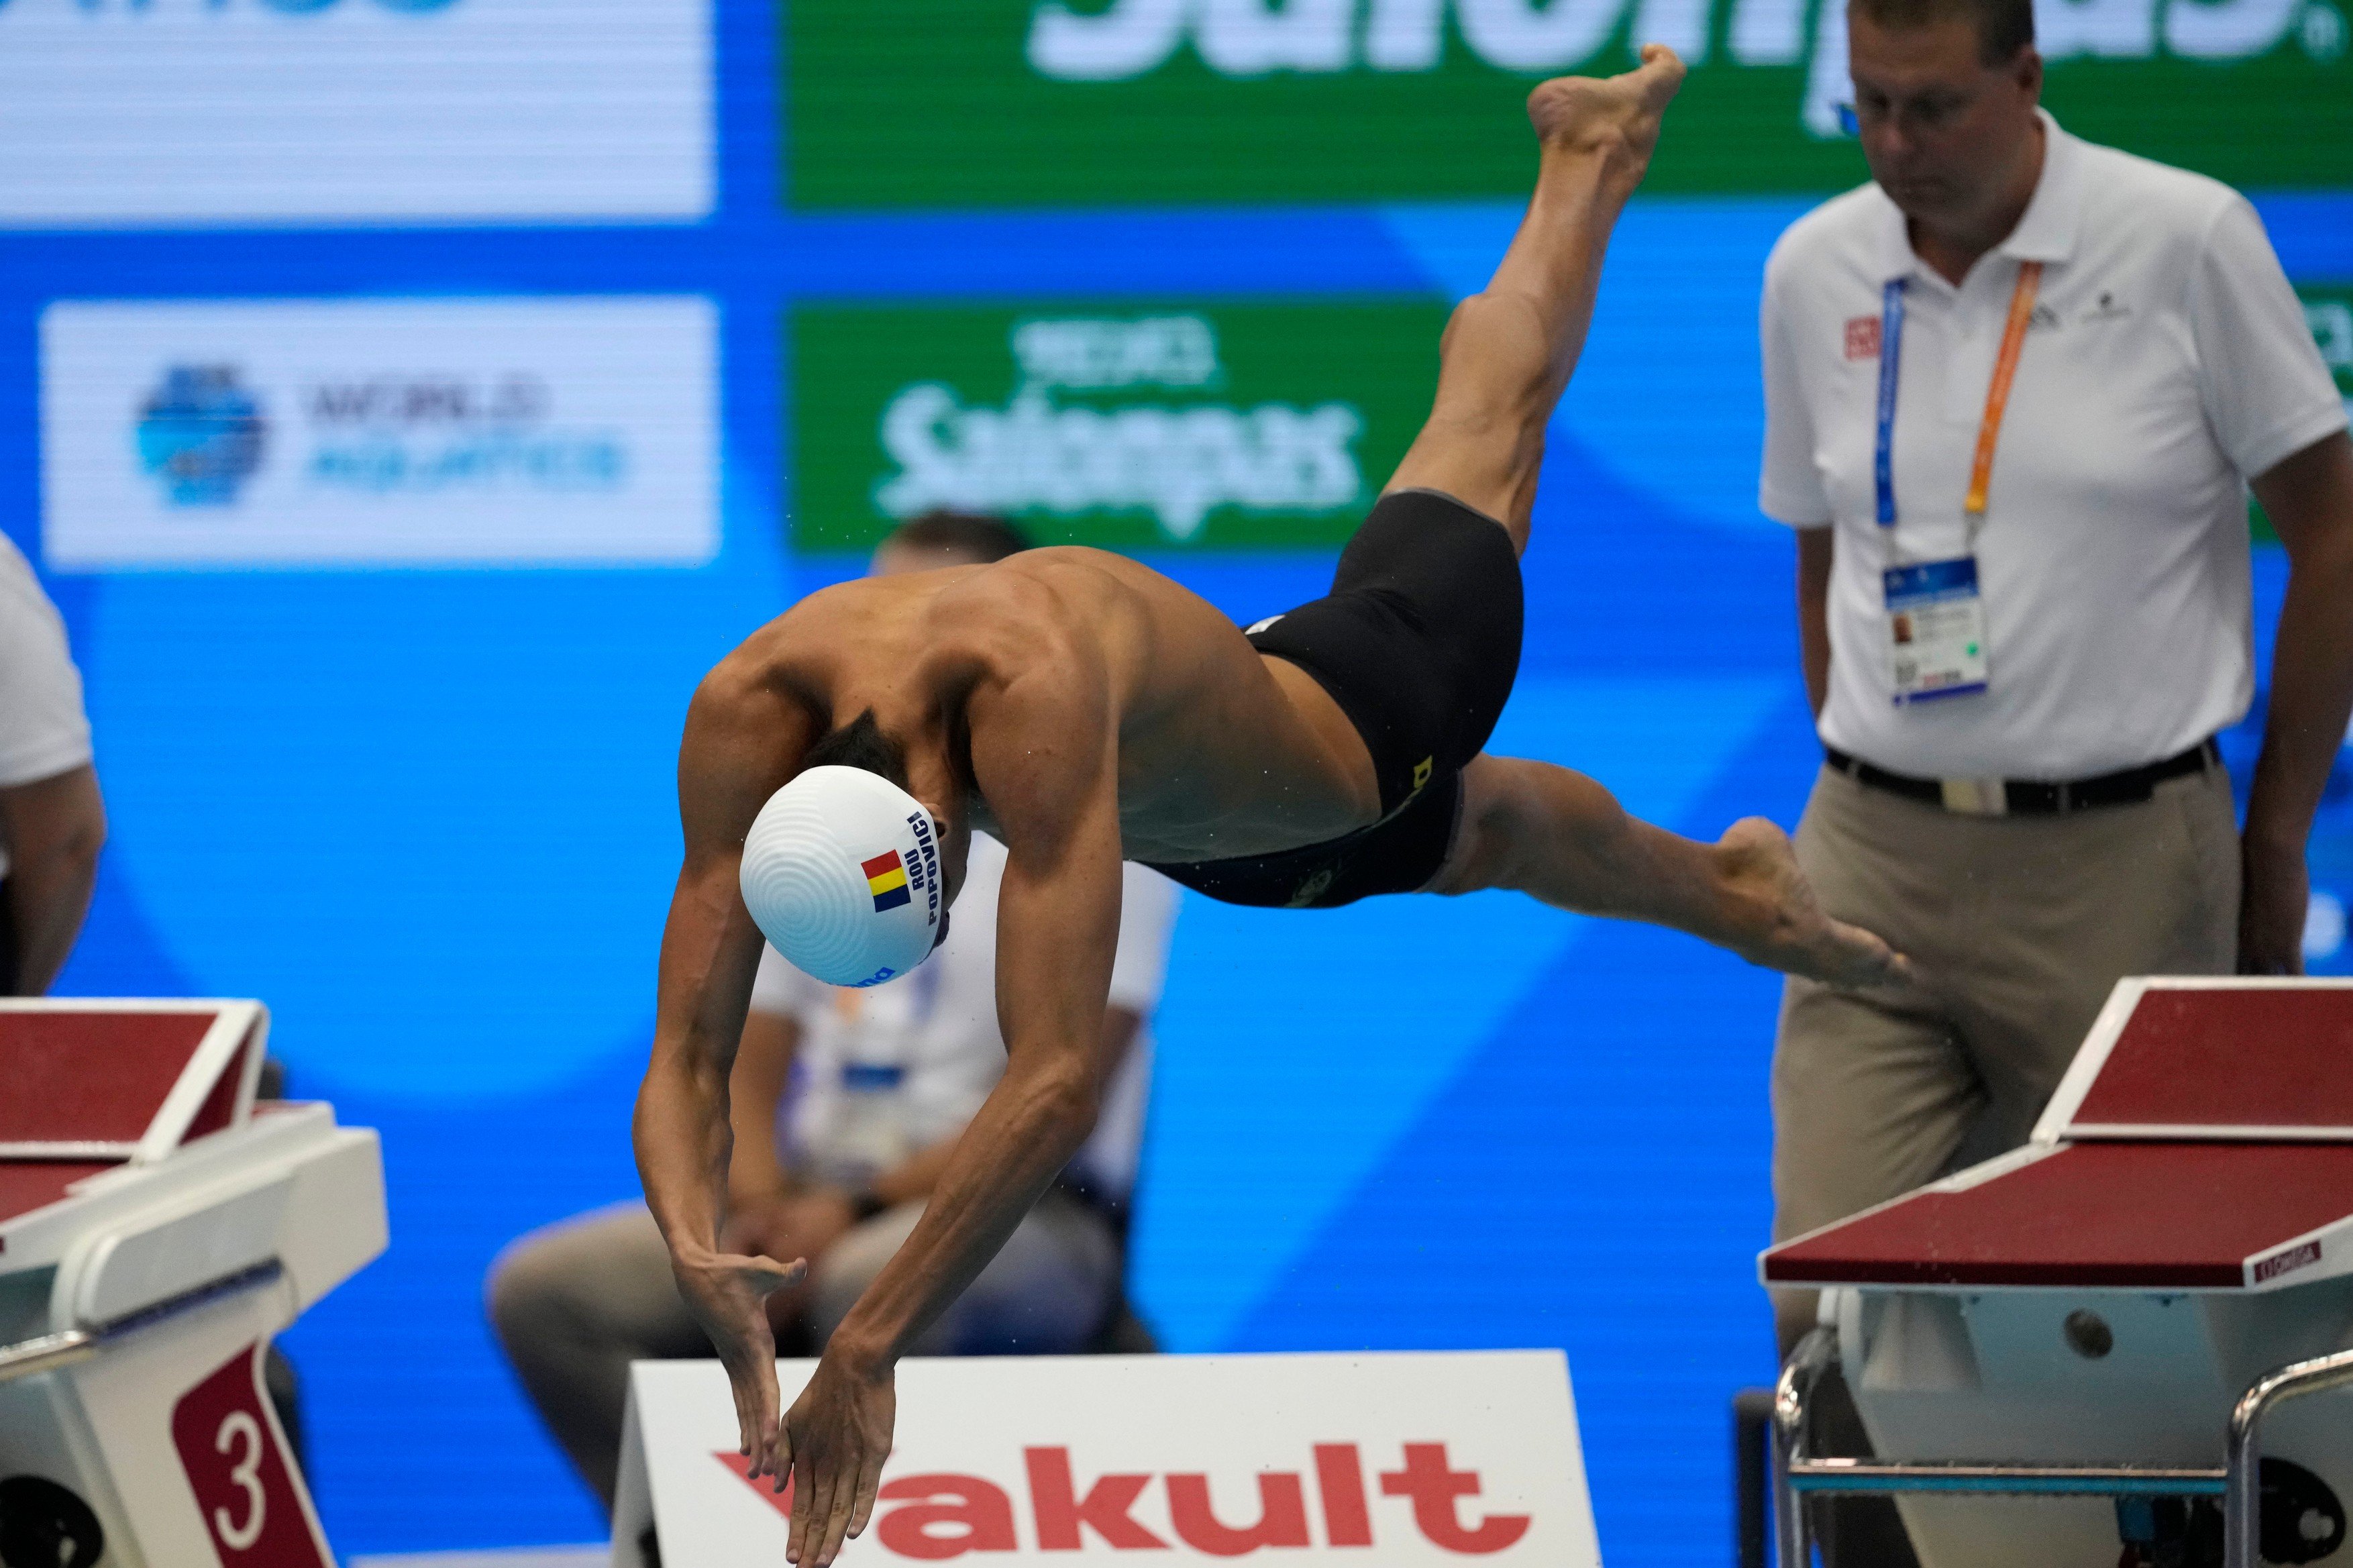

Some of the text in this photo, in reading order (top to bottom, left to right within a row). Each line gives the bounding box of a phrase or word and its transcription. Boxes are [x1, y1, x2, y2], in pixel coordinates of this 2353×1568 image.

[904, 848, 925, 891] ROU
[906, 811, 938, 927] POPOVICI
[215, 1410, 266, 1551] 3
